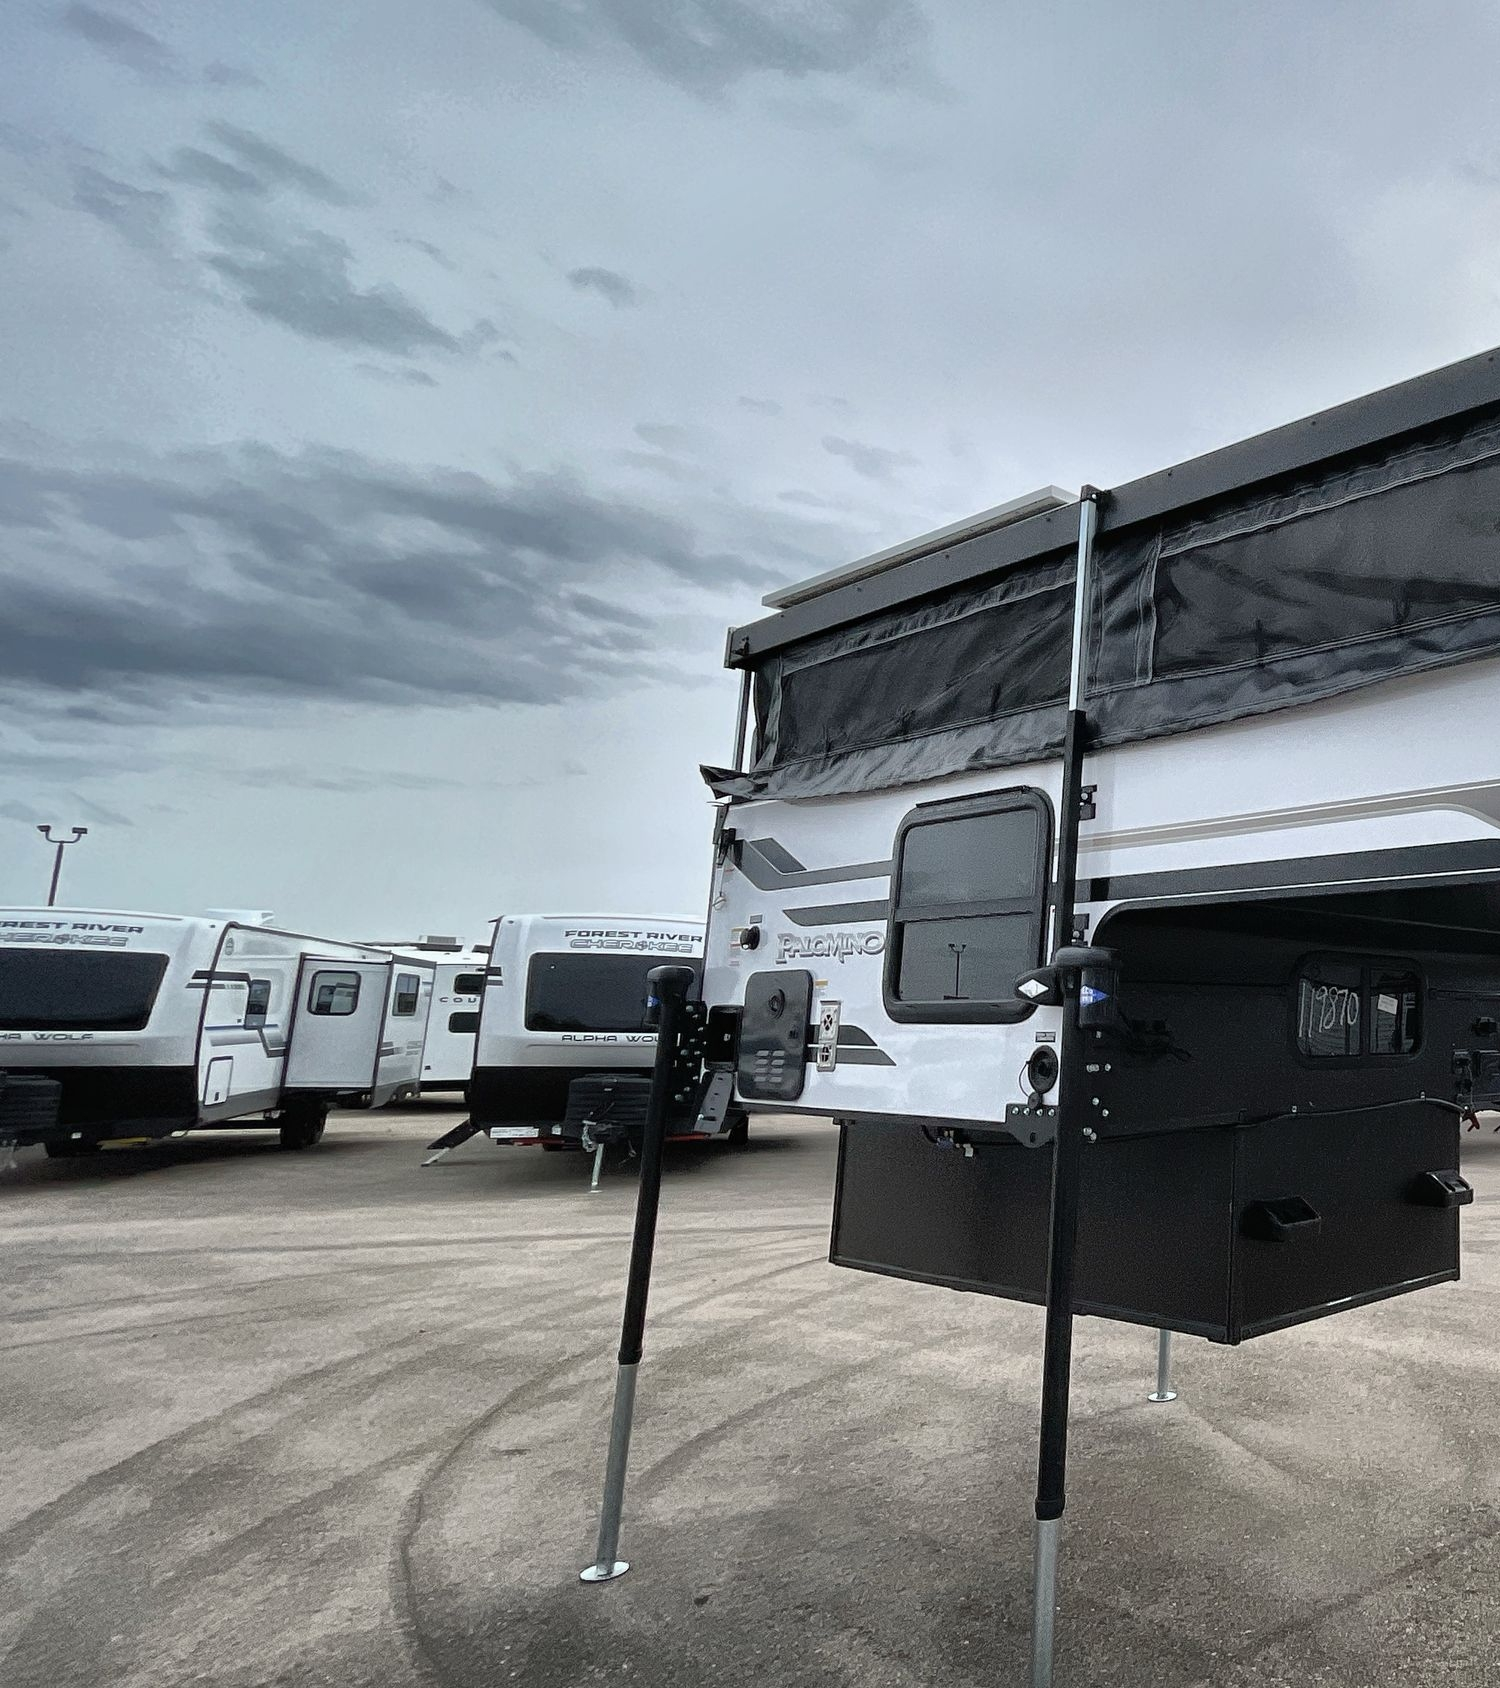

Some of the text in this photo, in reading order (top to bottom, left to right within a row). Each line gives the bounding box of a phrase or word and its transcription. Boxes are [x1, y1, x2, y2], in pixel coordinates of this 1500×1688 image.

[0, 921, 144, 934] REST RIVER
[564, 930, 703, 942] FOREST RIVER
[775, 931, 885, 964] PALOMINO
[33, 1033, 94, 1041] WOLF
[561, 1034, 618, 1042] ALPHA
